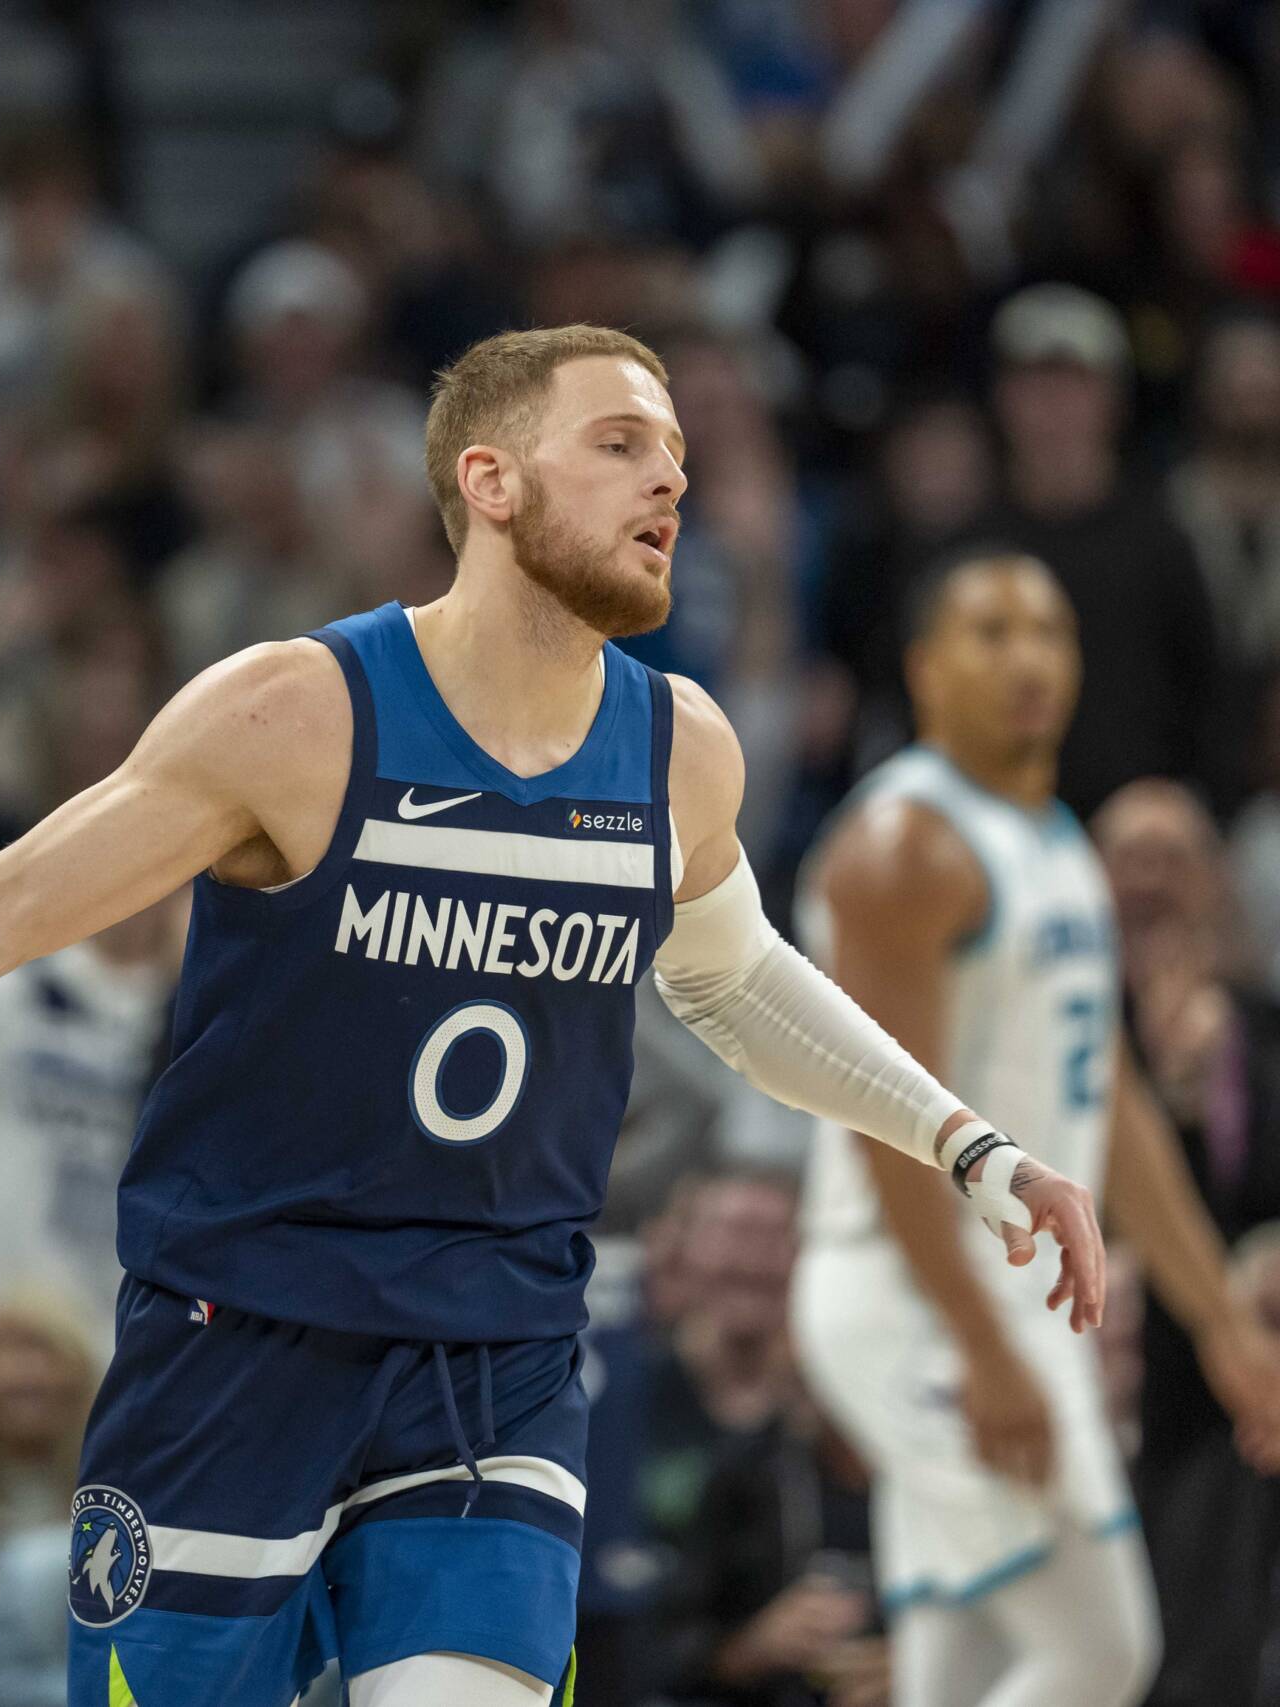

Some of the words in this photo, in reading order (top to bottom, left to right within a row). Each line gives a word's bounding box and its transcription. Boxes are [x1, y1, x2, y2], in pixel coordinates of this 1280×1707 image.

[582, 811, 643, 832] sezzle
[334, 883, 640, 985] MINNESOTA
[408, 999, 534, 1147] 0
[103, 1493, 148, 1605] TIMBERWOLVES
